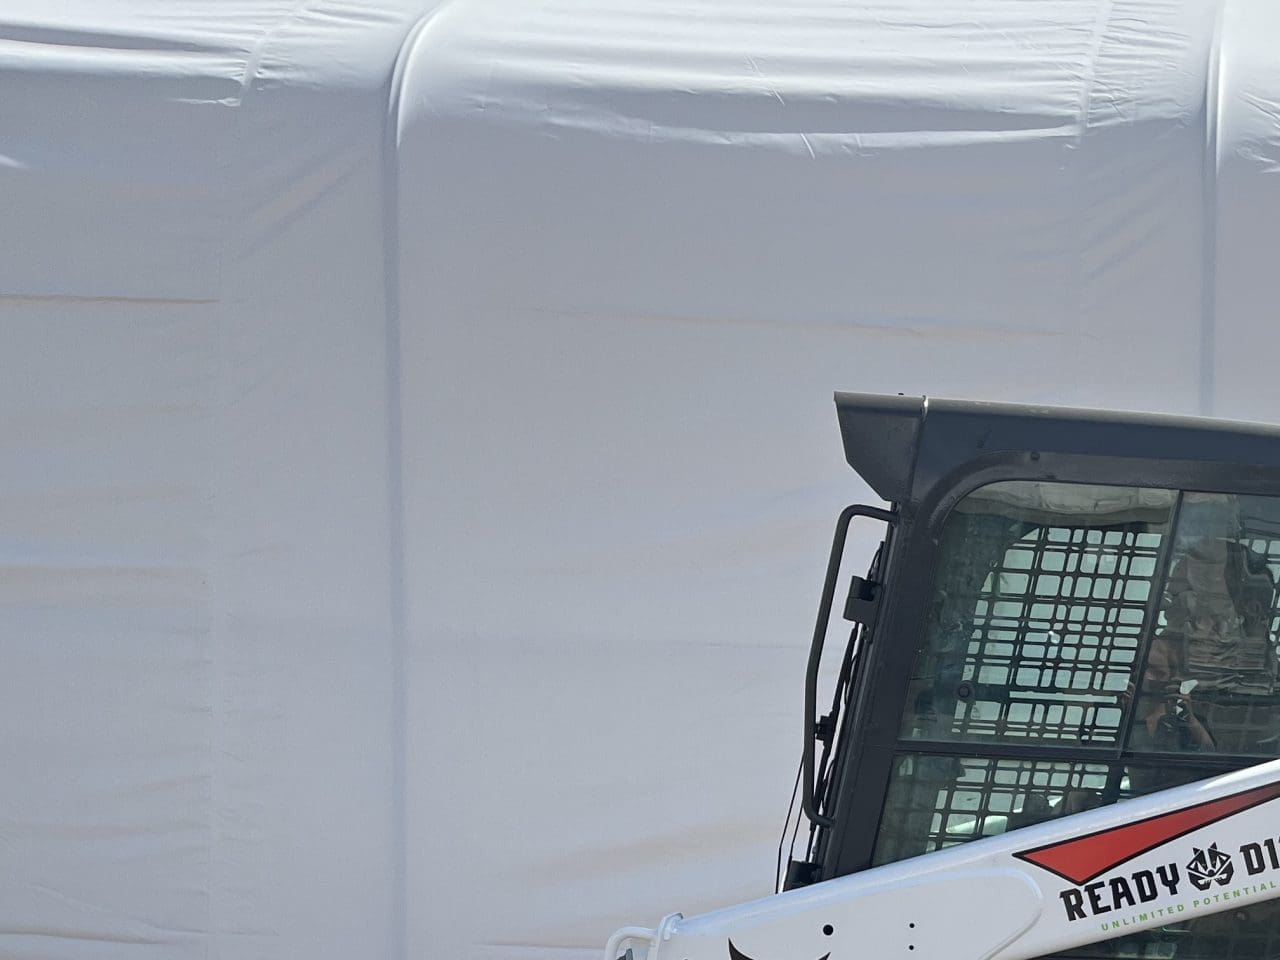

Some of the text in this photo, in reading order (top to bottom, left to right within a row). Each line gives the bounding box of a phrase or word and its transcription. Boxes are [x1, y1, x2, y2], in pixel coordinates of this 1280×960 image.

[1059, 862, 1180, 922] READY
[1101, 881, 1277, 931] UNLIMITED POTENTIAL
